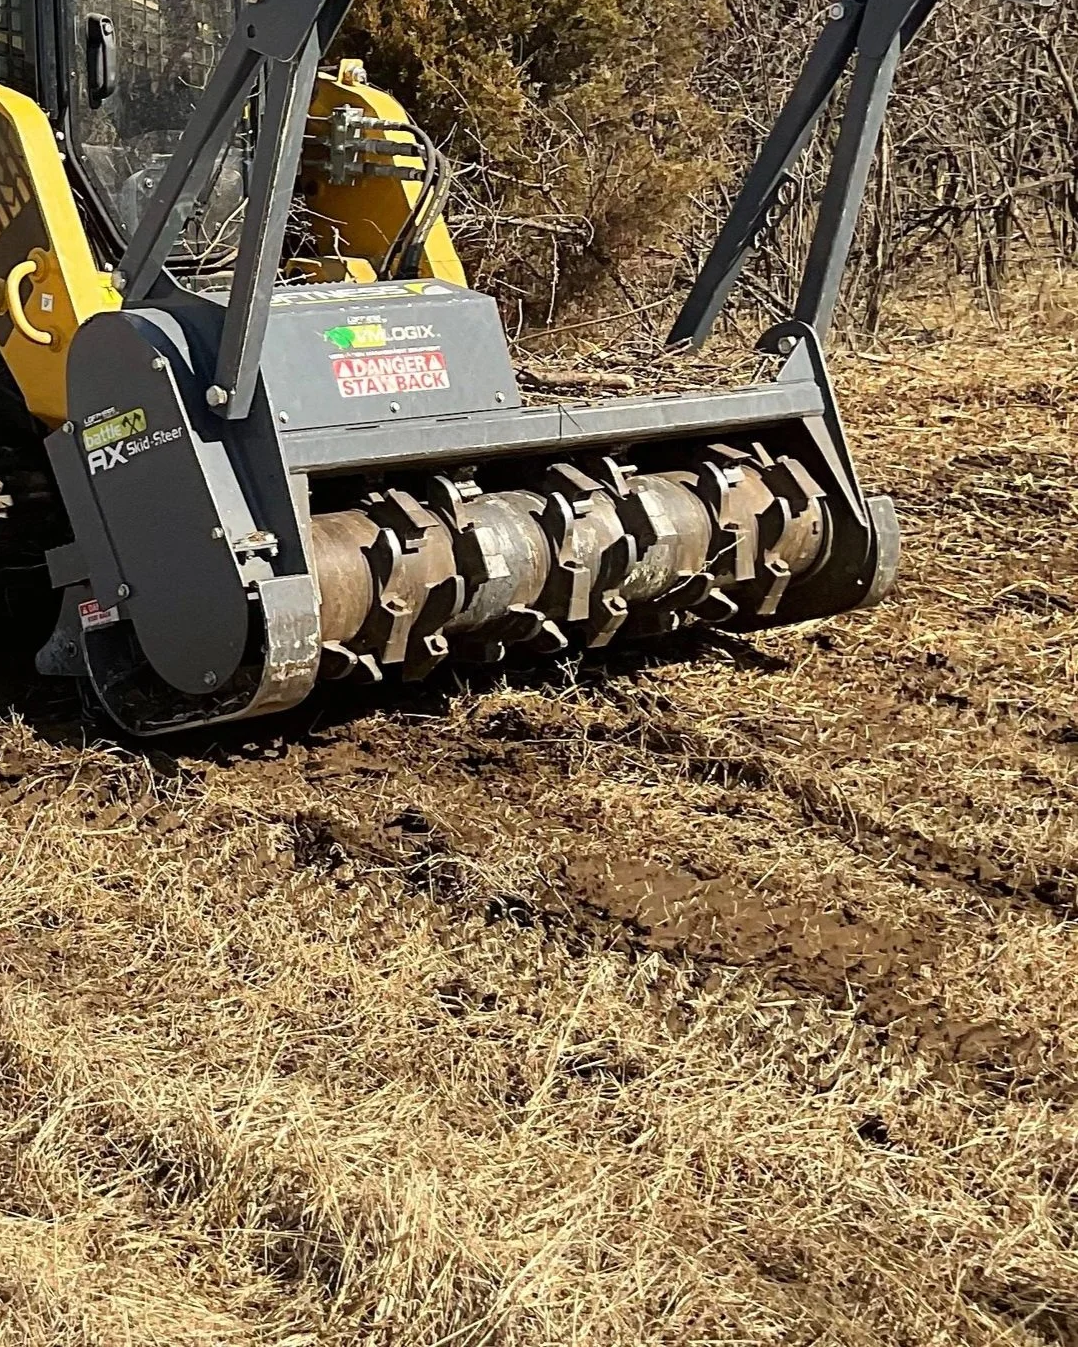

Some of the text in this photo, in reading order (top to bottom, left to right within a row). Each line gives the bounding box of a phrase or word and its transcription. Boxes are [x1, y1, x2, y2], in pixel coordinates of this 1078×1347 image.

[270, 285, 409, 303] FTNESS
[352, 354, 428, 378] DANGER
[342, 371, 446, 395] STAY BACK
[83, 423, 123, 449] battle
[87, 426, 183, 476] AX Skid-Steer
